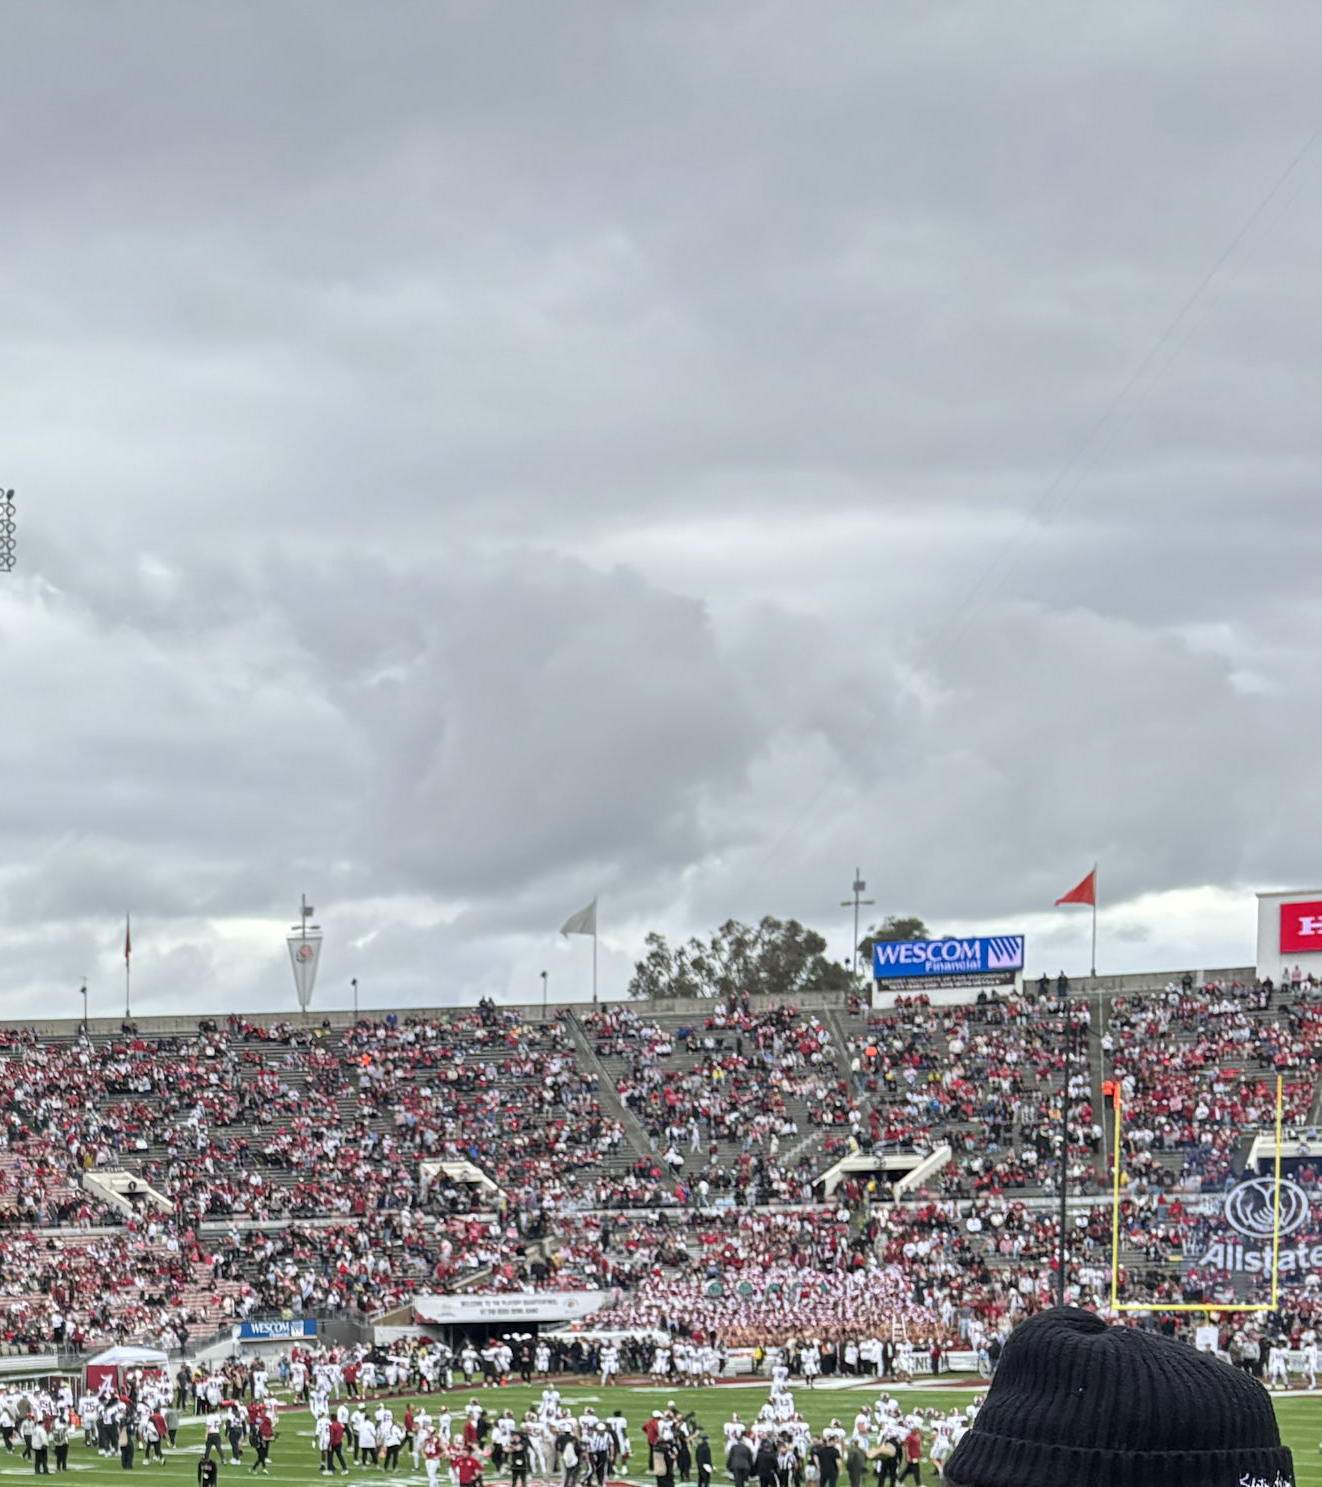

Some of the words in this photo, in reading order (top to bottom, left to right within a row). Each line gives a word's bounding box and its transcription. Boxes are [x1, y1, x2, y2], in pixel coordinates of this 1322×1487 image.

[877, 939, 981, 965] WESCOM
[925, 959, 981, 972] Financial
[1199, 1242, 1322, 1273] Allstate
[251, 1322, 289, 1334] WESCOM
